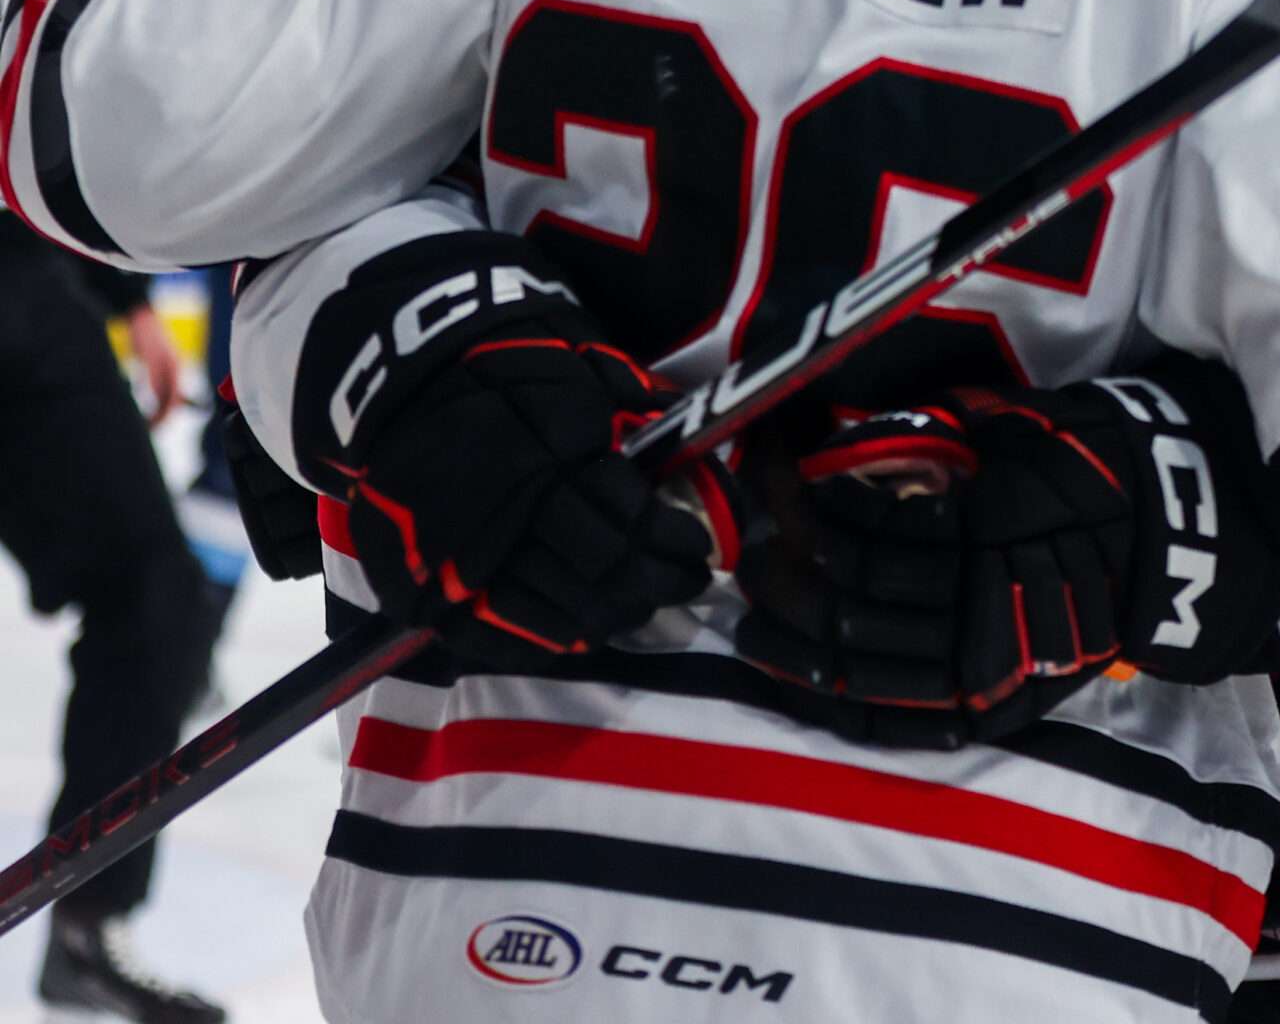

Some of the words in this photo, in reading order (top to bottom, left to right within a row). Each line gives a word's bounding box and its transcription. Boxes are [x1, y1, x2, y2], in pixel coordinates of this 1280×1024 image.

[328, 265, 583, 448] CCM
[621, 232, 939, 453] RUE
[1096, 377, 1219, 649] CCM
[484, 927, 558, 970] AHL
[601, 946, 796, 1003] CCM
